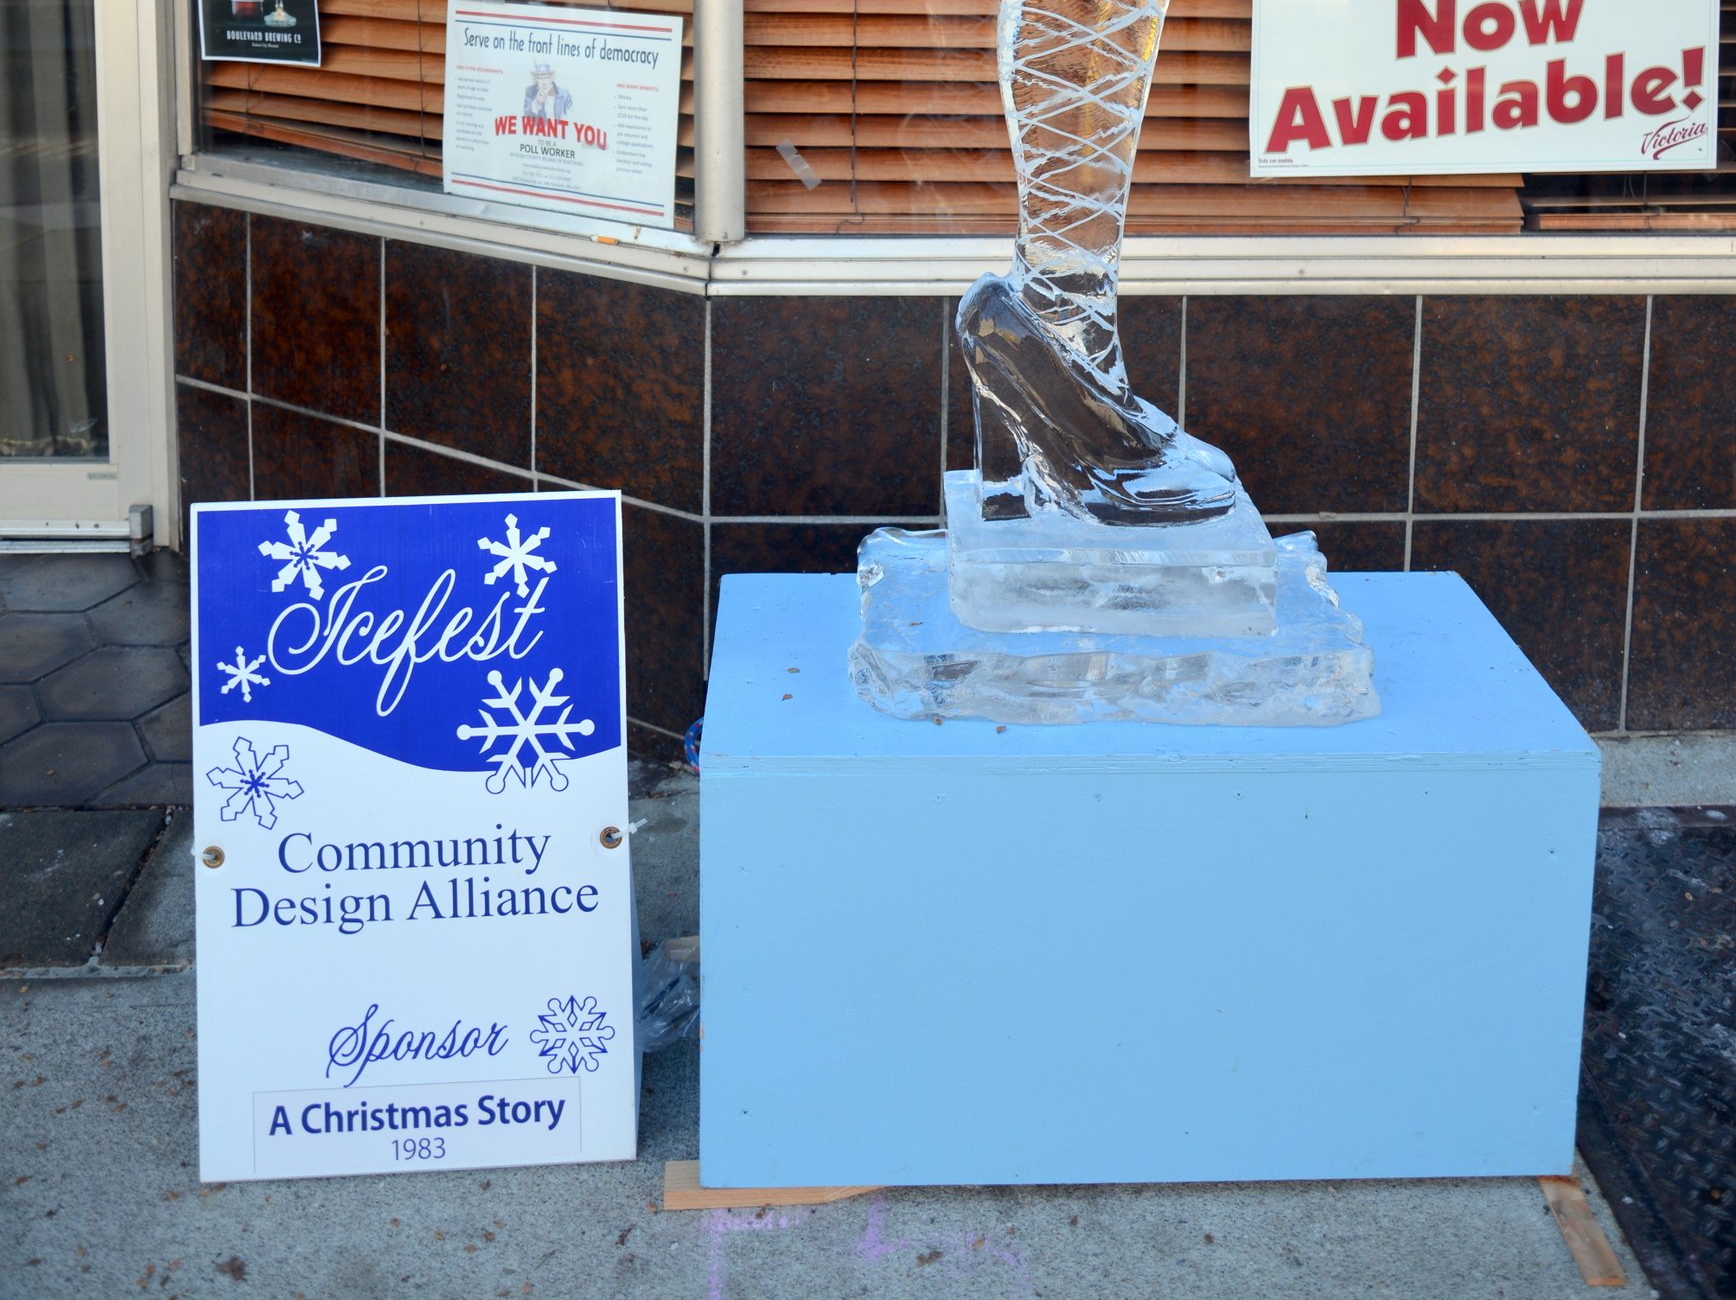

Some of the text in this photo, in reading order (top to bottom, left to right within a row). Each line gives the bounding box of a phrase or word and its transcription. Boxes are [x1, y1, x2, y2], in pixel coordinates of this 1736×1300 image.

[226, 30, 263, 41] BOULEVARD
[264, 32, 292, 43] BREWING
[464, 27, 659, 69] Serve on the front lines of democracy
[1263, 45, 1707, 156] Available!
[495, 115, 607, 150] WE WANT YOU
[520, 143, 576, 159] POLL WORKER
[1641, 114, 1708, 160] Victoria
[267, 565, 551, 717] Icefest
[277, 823, 552, 875] Community
[230, 876, 600, 935] Design Alliance
[326, 1003, 509, 1088] Sponsor
[269, 1094, 566, 1136] A Christmas Story
[391, 1137, 446, 1161] 1983
